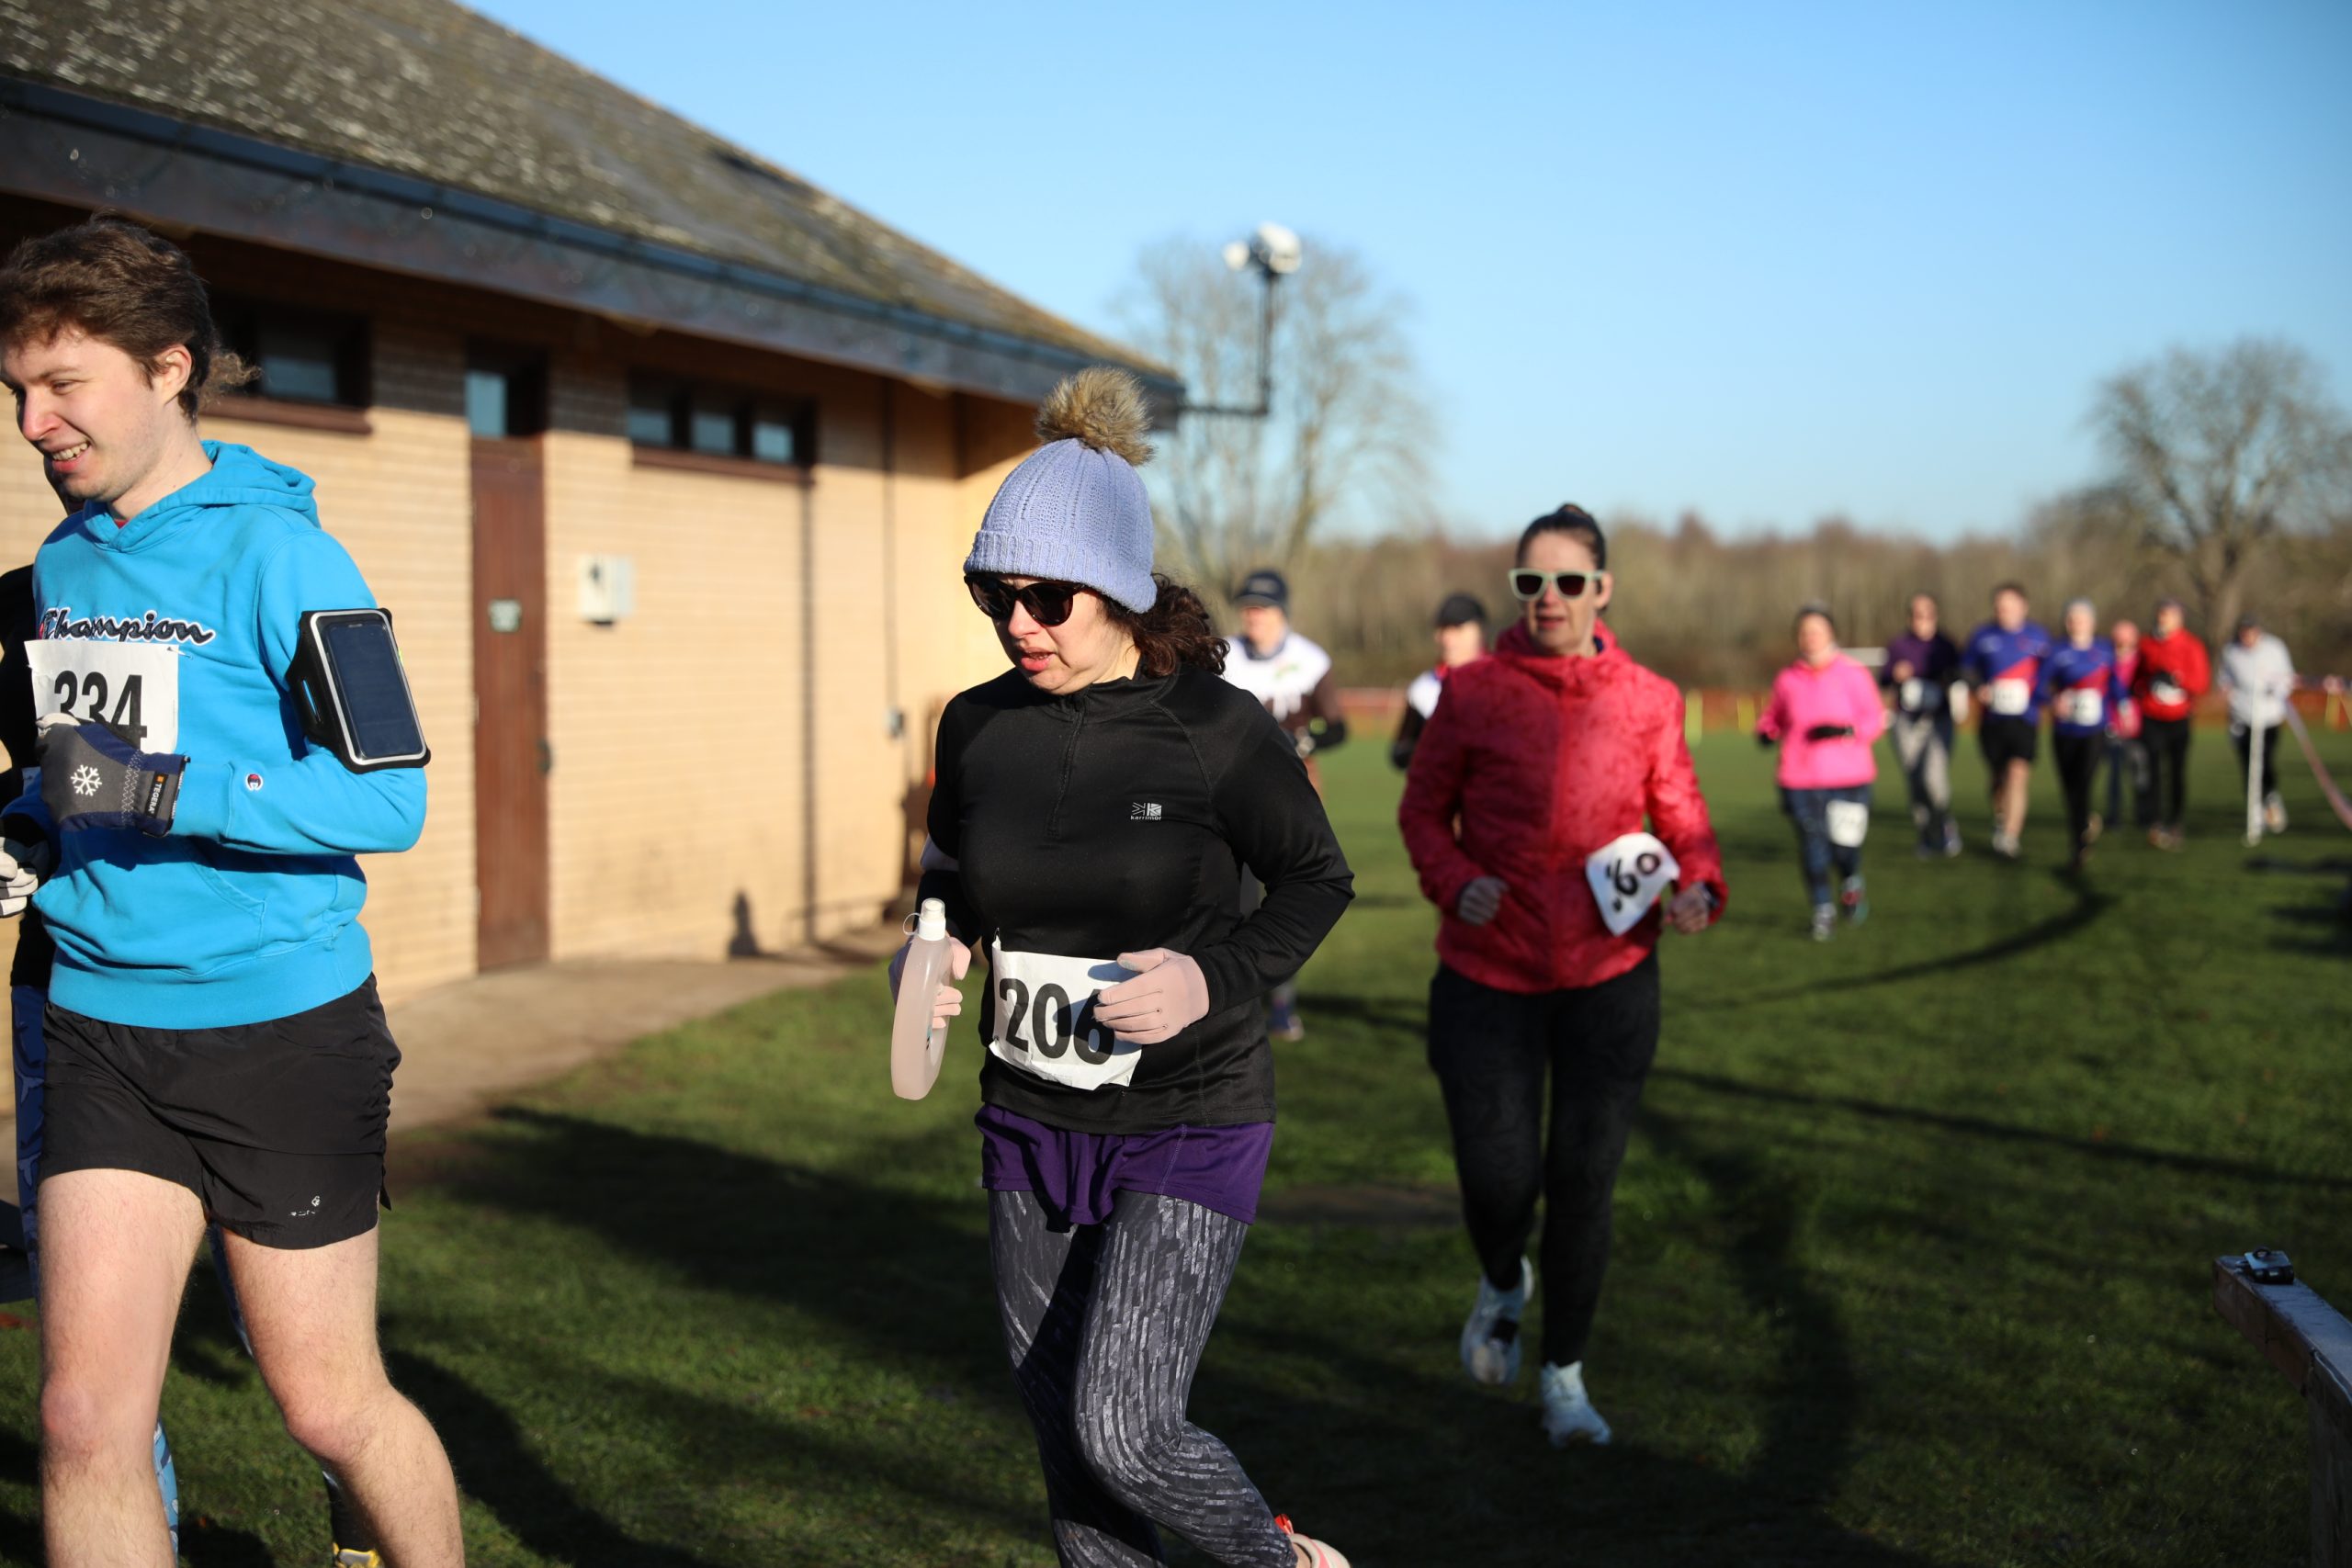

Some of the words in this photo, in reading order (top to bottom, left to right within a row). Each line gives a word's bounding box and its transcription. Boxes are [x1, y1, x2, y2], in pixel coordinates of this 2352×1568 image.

[40, 607, 216, 645] Champion
[53, 670, 148, 751] 334
[1605, 852, 1661, 912] 60
[999, 977, 1115, 1066] 206
